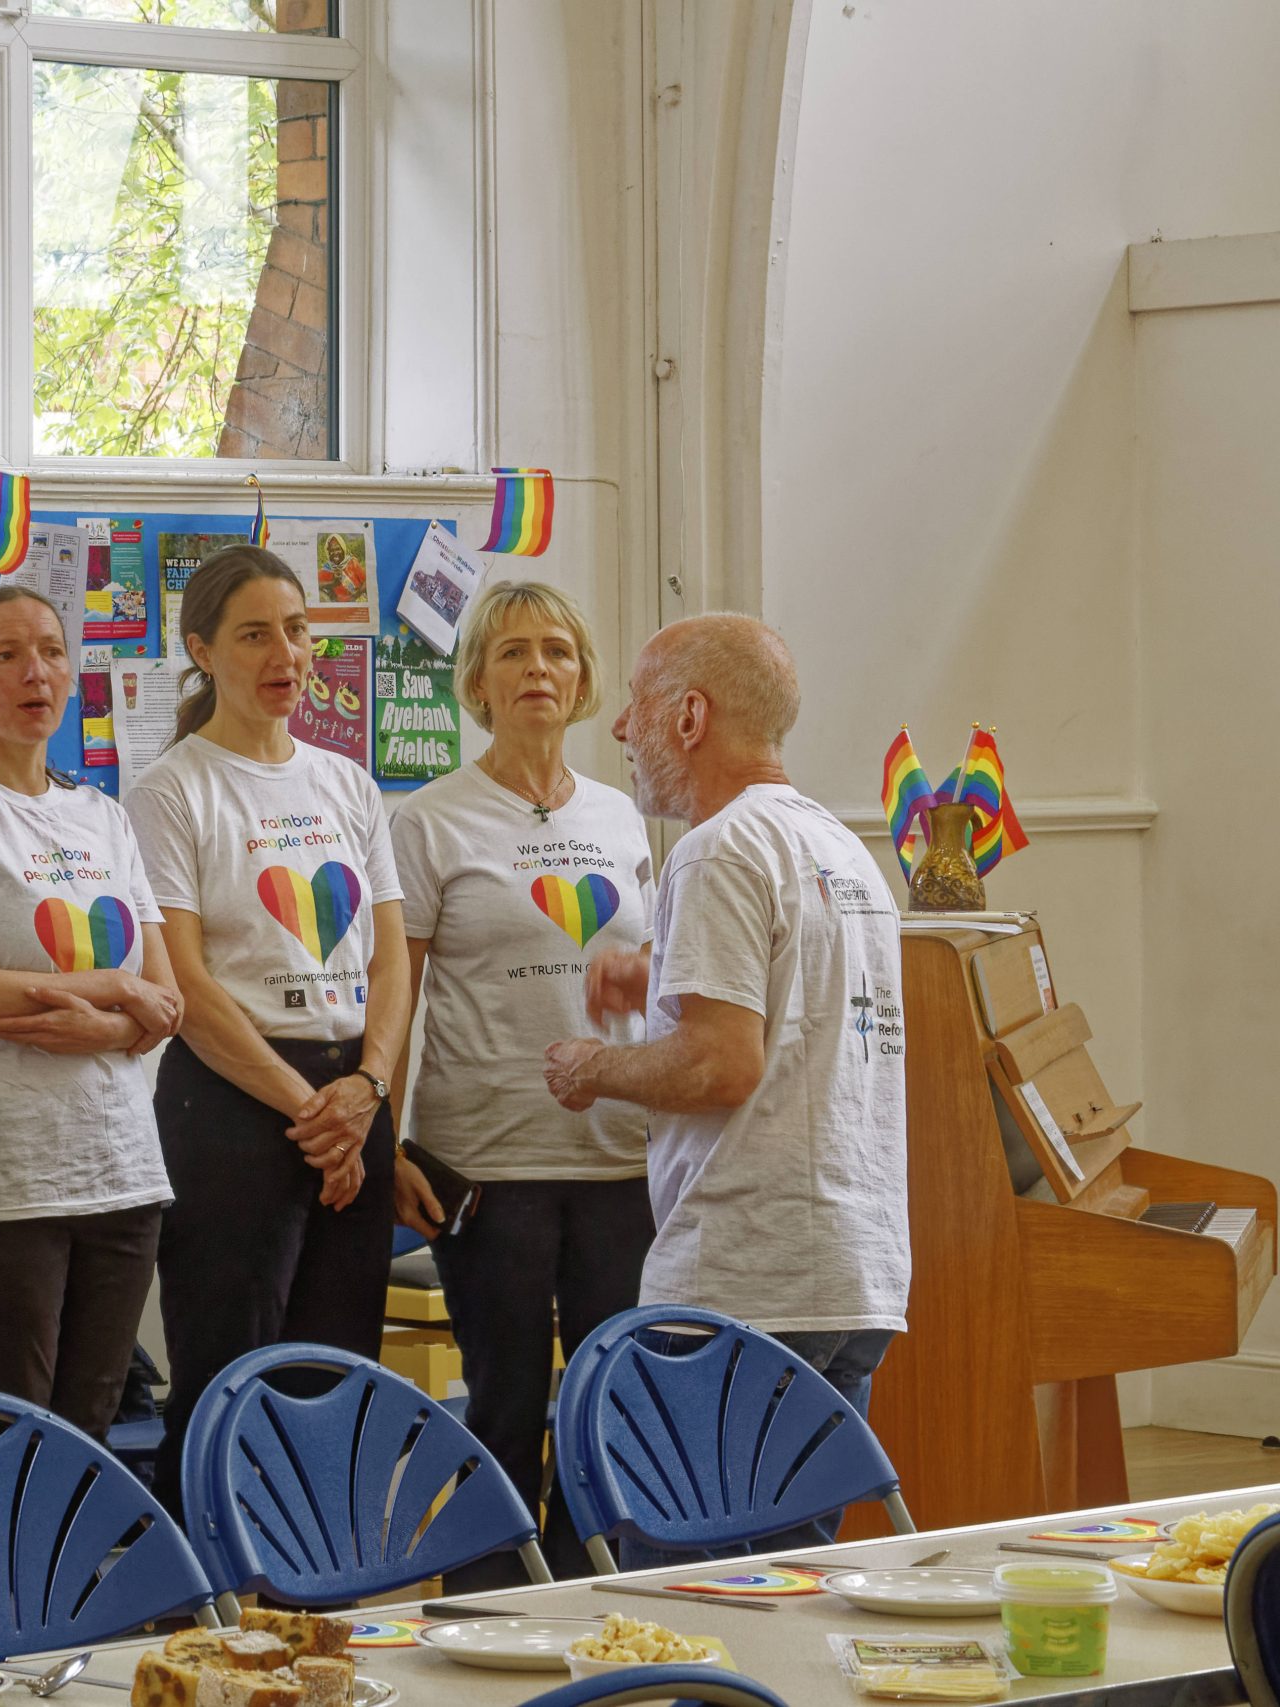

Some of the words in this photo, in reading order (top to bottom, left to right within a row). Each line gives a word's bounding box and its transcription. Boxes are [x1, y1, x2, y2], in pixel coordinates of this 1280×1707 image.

[166, 559, 178, 567] WE
[179, 559, 195, 567] ARE
[402, 669, 434, 699] Save
[380, 701, 457, 733] Ryebank
[384, 736, 451, 766] Fields
[260, 814, 323, 830] rainbow
[246, 834, 301, 854] people
[304, 831, 343, 847] choir
[517, 844, 539, 856] We
[543, 842, 566, 853] are
[569, 839, 602, 854] God's
[31, 847, 91, 864] rainbow
[513, 856, 570, 871] rainbow
[573, 856, 615, 869] people
[23, 869, 74, 884] people
[77, 867, 111, 881] choir
[507, 967, 527, 979] WE
[530, 963, 568, 976] TRUST
[571, 963, 582, 974] IN
[875, 987, 891, 999] The
[876, 1004, 901, 1018] Unite
[878, 1022, 902, 1036] Refo
[880, 1041, 903, 1055] Churc
